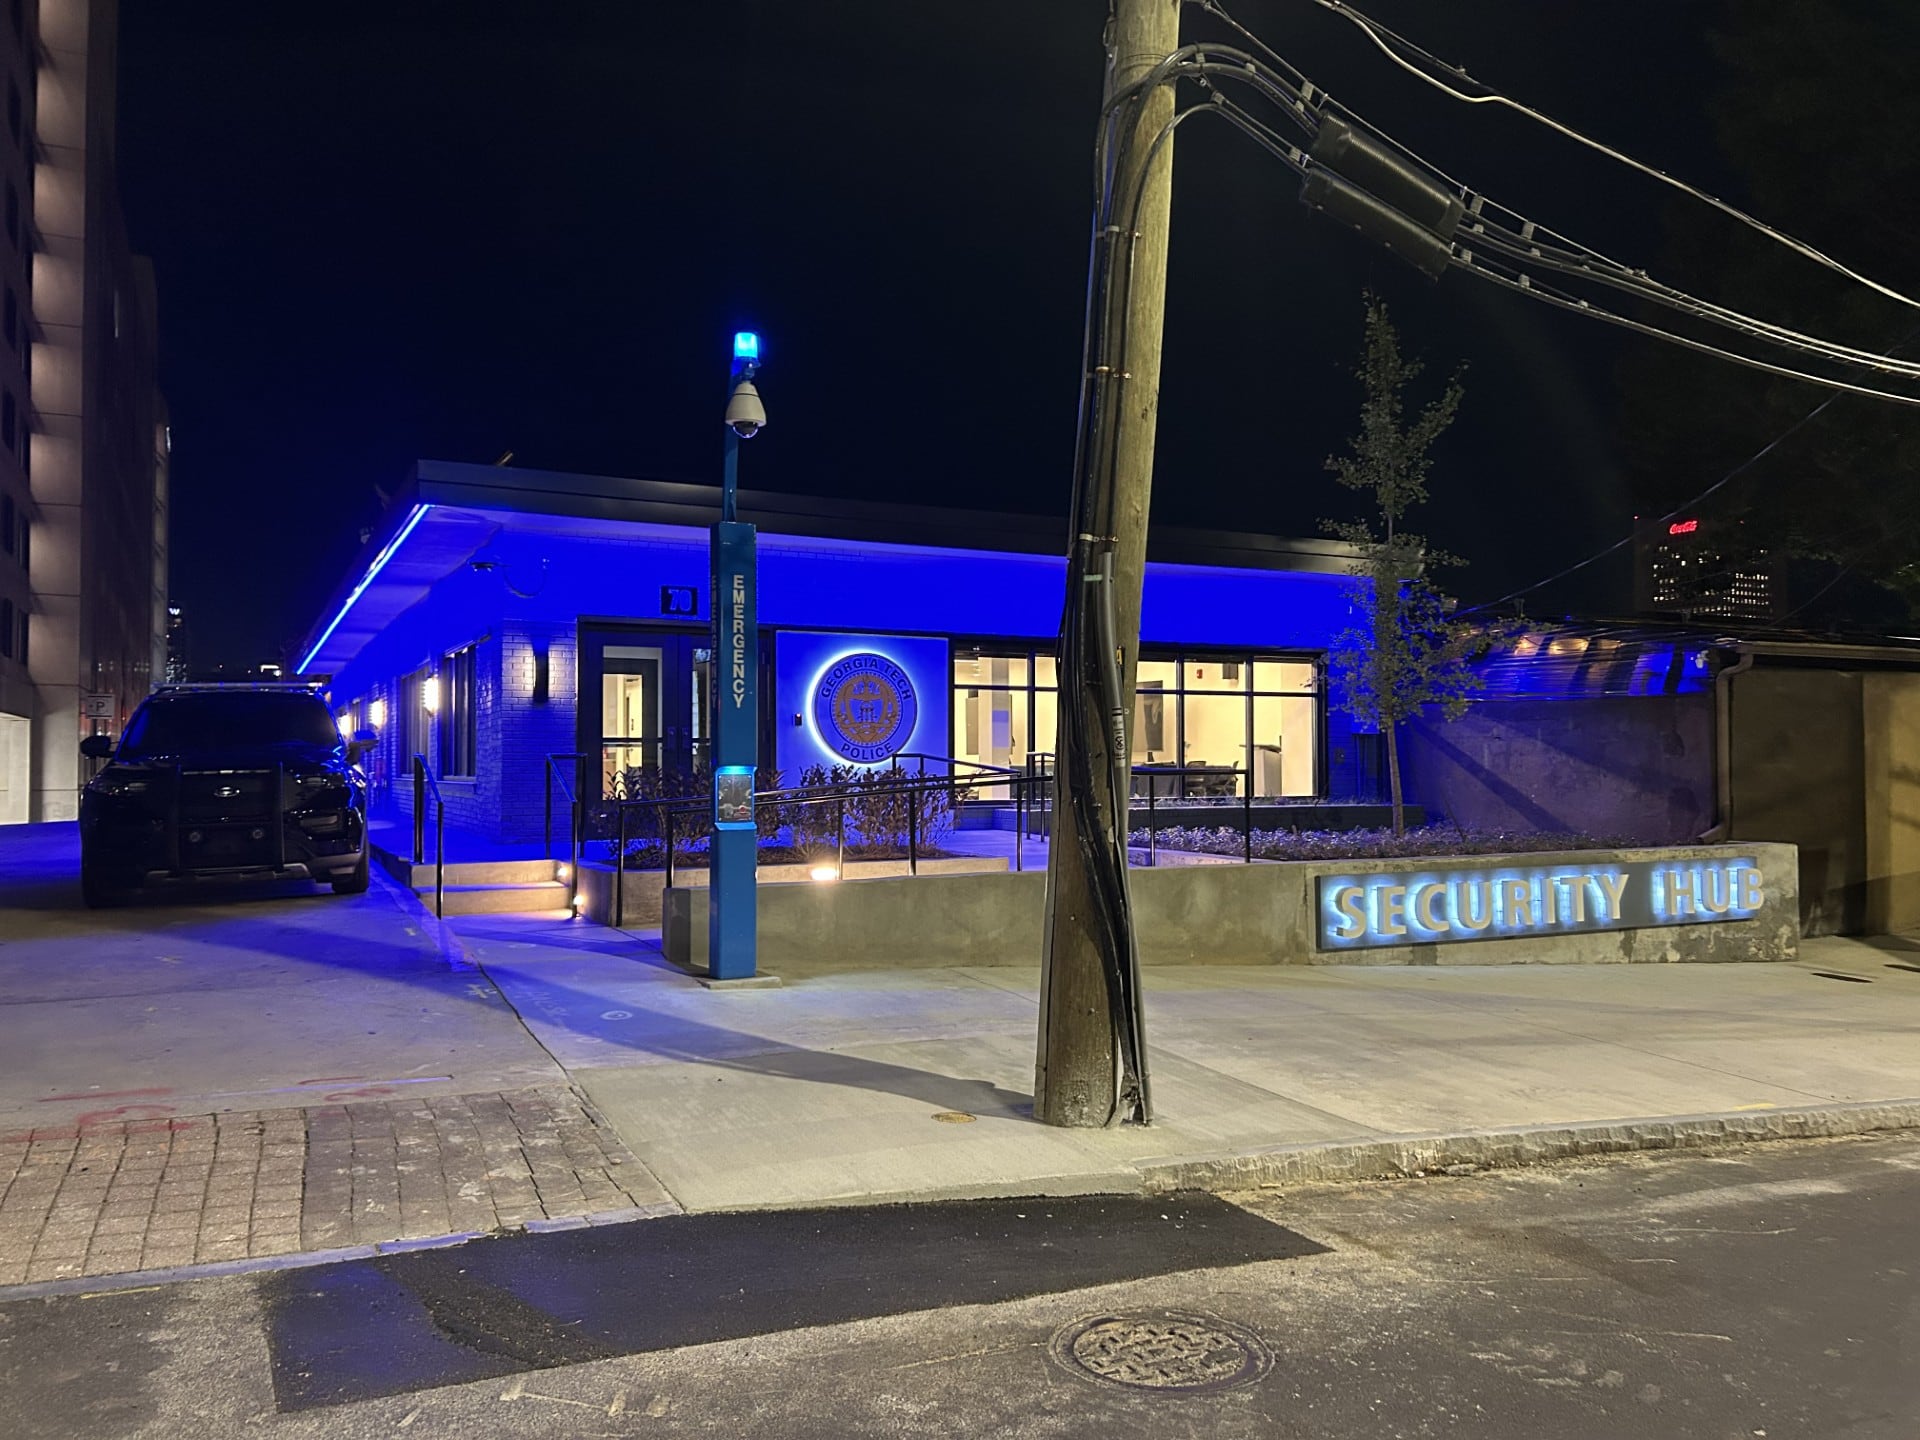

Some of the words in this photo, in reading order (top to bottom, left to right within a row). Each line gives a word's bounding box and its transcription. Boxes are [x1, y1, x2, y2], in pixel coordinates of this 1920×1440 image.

[668, 589, 692, 611] 70
[732, 574, 745, 709] EMERGENCY
[821, 658, 878, 698] GEORGIA
[885, 664, 912, 700] TECH
[840, 742, 894, 760] POLICE
[1335, 874, 1630, 940] SECURITY
[1663, 868, 1765, 916] HUB
